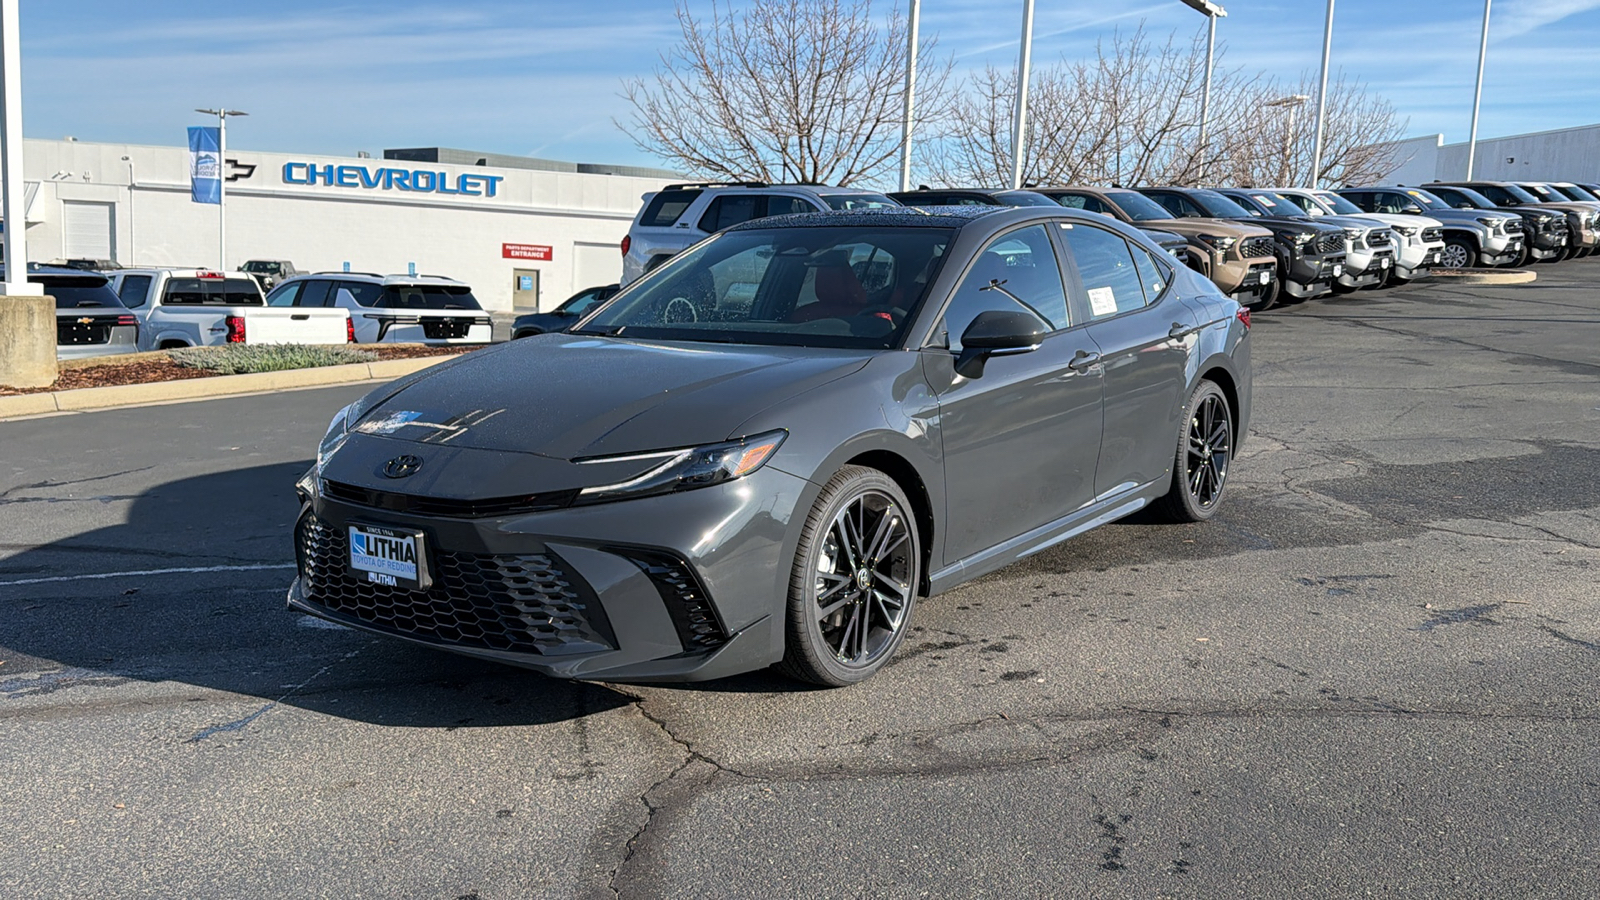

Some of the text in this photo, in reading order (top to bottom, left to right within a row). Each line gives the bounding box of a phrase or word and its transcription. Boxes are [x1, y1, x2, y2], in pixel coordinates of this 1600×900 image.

[283, 162, 504, 197] CHEVROLET
[511, 250, 544, 258] ENTRANCE
[366, 527, 382, 535] SINCE
[366, 535, 416, 563] LITHIA
[353, 555, 416, 574] TOYOTA OF REDDING
[376, 572, 398, 587] LITHIA
